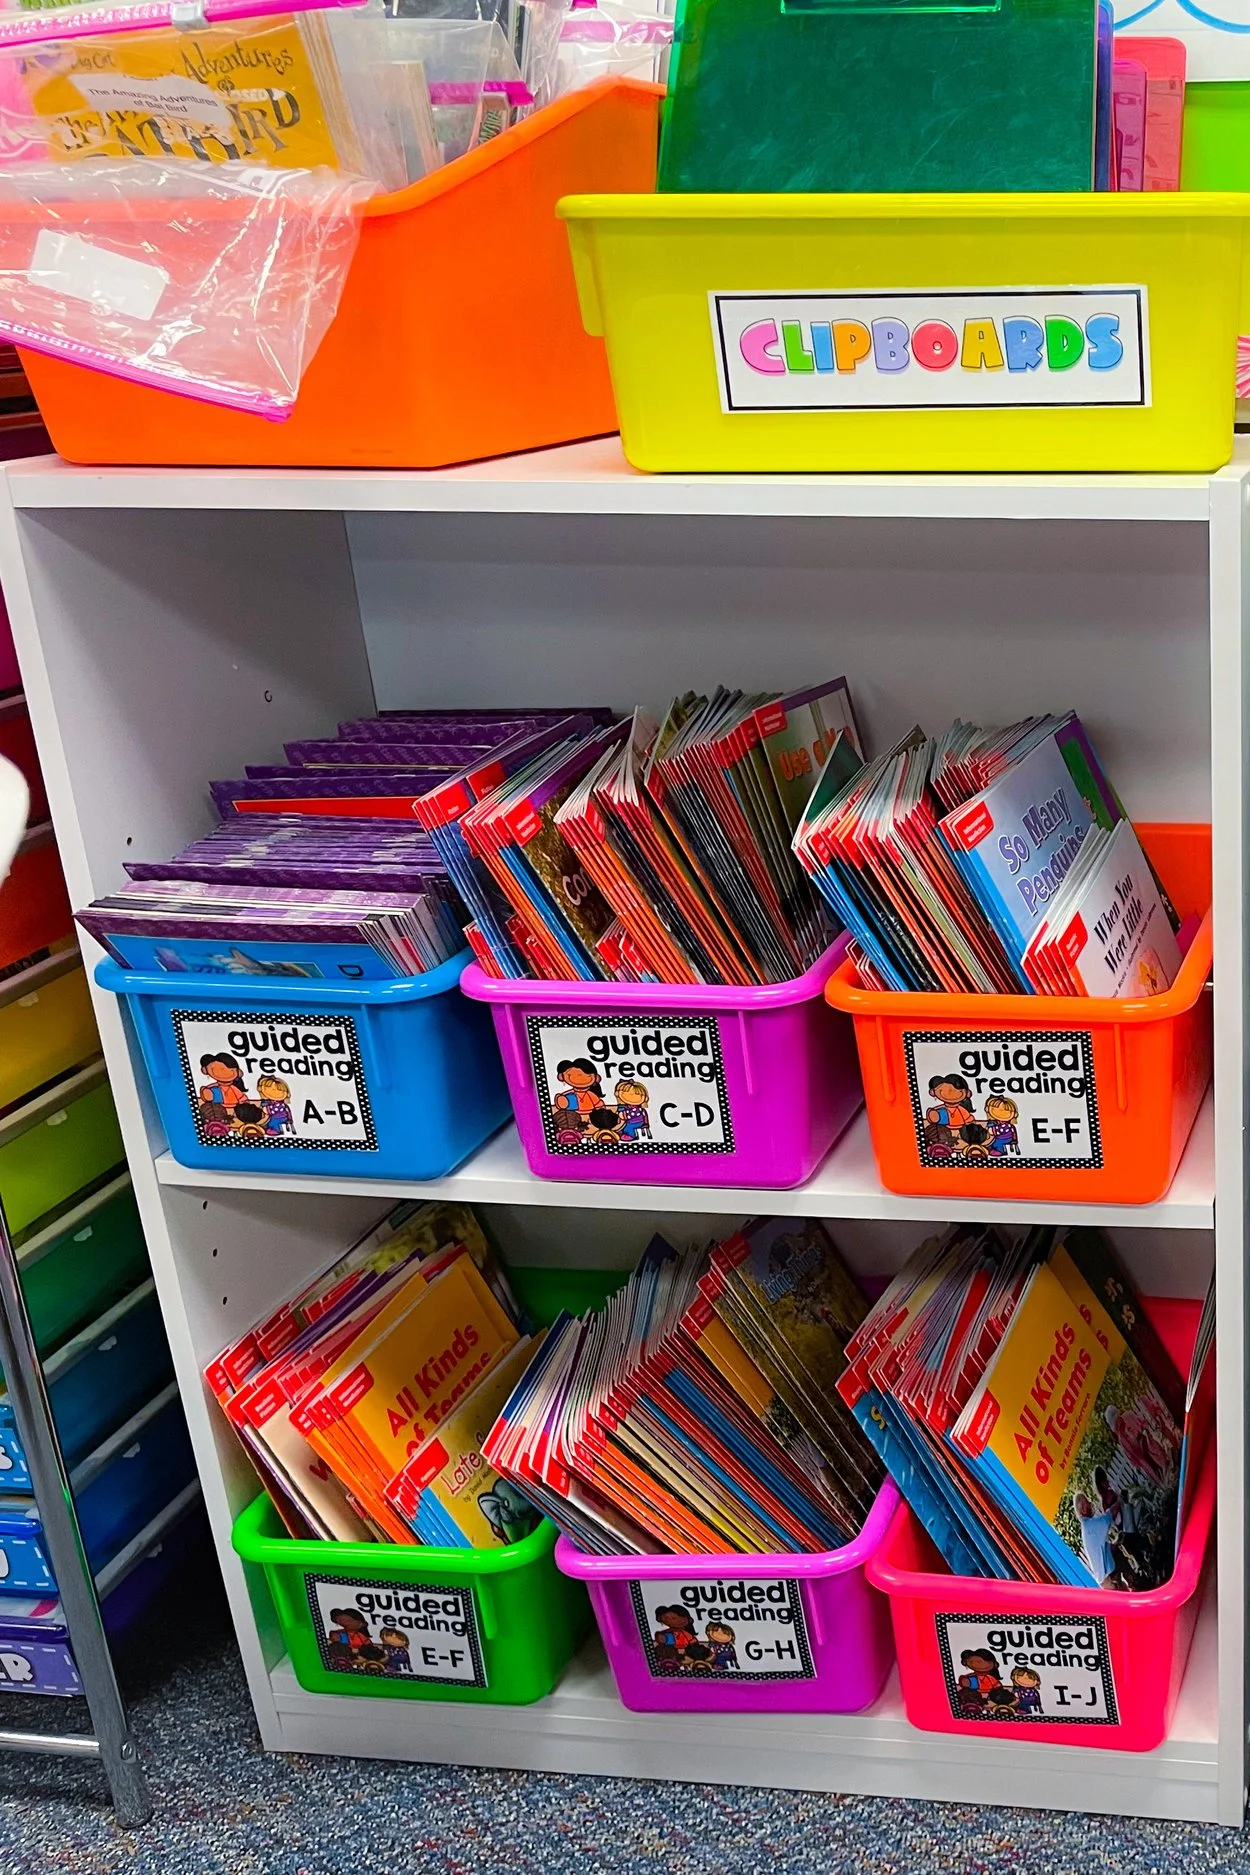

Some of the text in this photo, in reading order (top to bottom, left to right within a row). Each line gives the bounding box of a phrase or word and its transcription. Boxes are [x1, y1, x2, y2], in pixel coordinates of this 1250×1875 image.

[87, 88, 219, 107] The Amazing Adventures
[165, 103, 188, 113] Bird
[739, 313, 1124, 376] CLIPBOARDS
[998, 787, 1072, 875] So Many
[1093, 873, 1134, 946] When You
[1104, 932, 1128, 976] Were
[1122, 897, 1144, 951] Little
[228, 1025, 346, 1057] guided
[587, 1028, 709, 1062] guided
[245, 1055, 354, 1081] reading
[604, 1057, 715, 1083] reading
[959, 1044, 1080, 1077] guided
[975, 1072, 1086, 1099] reading
[303, 1100, 358, 1125] A-B
[659, 1102, 715, 1128] C-D
[1031, 1118, 1081, 1144] E-F
[386, 1324, 479, 1438] All Kinds
[1014, 1322, 1075, 1464] All Kinds
[1036, 1348, 1092, 1485] of Teams
[441, 1452, 481, 1495] Late
[355, 1591, 461, 1617] guided
[680, 1580, 786, 1608] guided
[370, 1612, 467, 1637] reading
[695, 1604, 794, 1625] reading
[745, 1640, 796, 1661] G-H
[987, 1625, 1095, 1652] guided
[421, 1646, 464, 1668] E-F
[1002, 1650, 1101, 1672] reading
[1054, 1685, 1097, 1707] I-J
